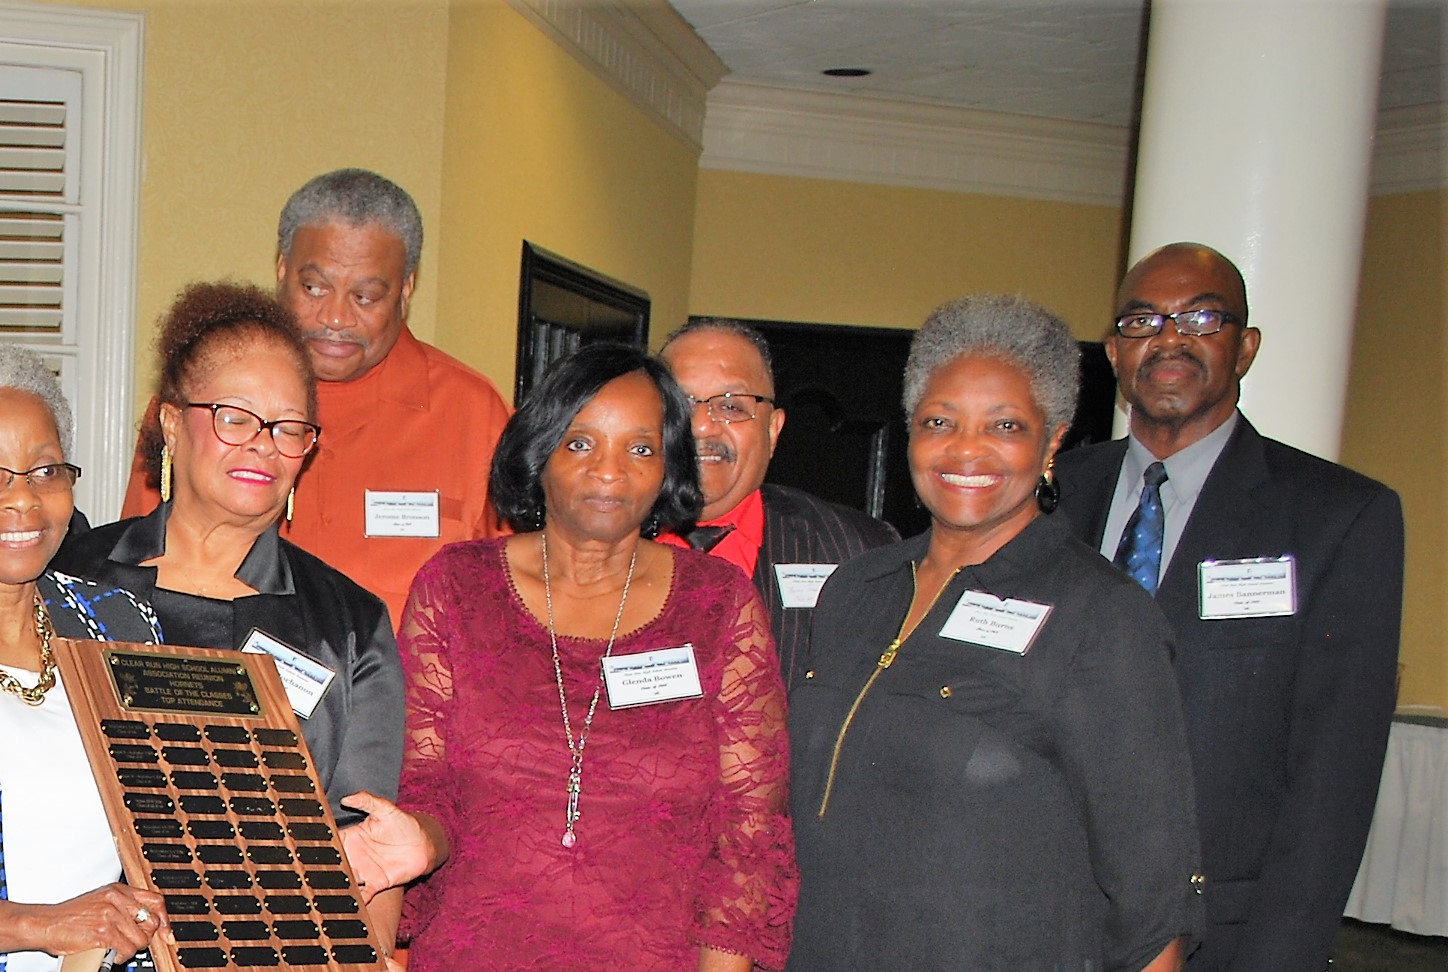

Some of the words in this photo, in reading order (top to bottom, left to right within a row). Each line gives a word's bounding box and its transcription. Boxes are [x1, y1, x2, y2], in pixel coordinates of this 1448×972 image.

[1237, 590, 1286, 598] Bannerman
[969, 615, 988, 625] Ruth
[121, 660, 144, 668] CLEAR
[145, 661, 162, 669] RUN
[162, 663, 181, 671] HIGH
[182, 664, 209, 673] SCHOOL
[143, 669, 191, 680] ASSOCIATION
[192, 673, 224, 682] REUNION
[622, 676, 652, 686] Glenda
[654, 673, 683, 682] Bowen
[169, 680, 204, 689] HORNETS
[144, 686, 171, 695] BATTLE
[174, 688, 184, 697] OF
[185, 689, 199, 698] THE
[201, 690, 232, 700] CLASSES
[161, 696, 175, 704] TOP
[177, 698, 224, 707] ATTENDANCE
